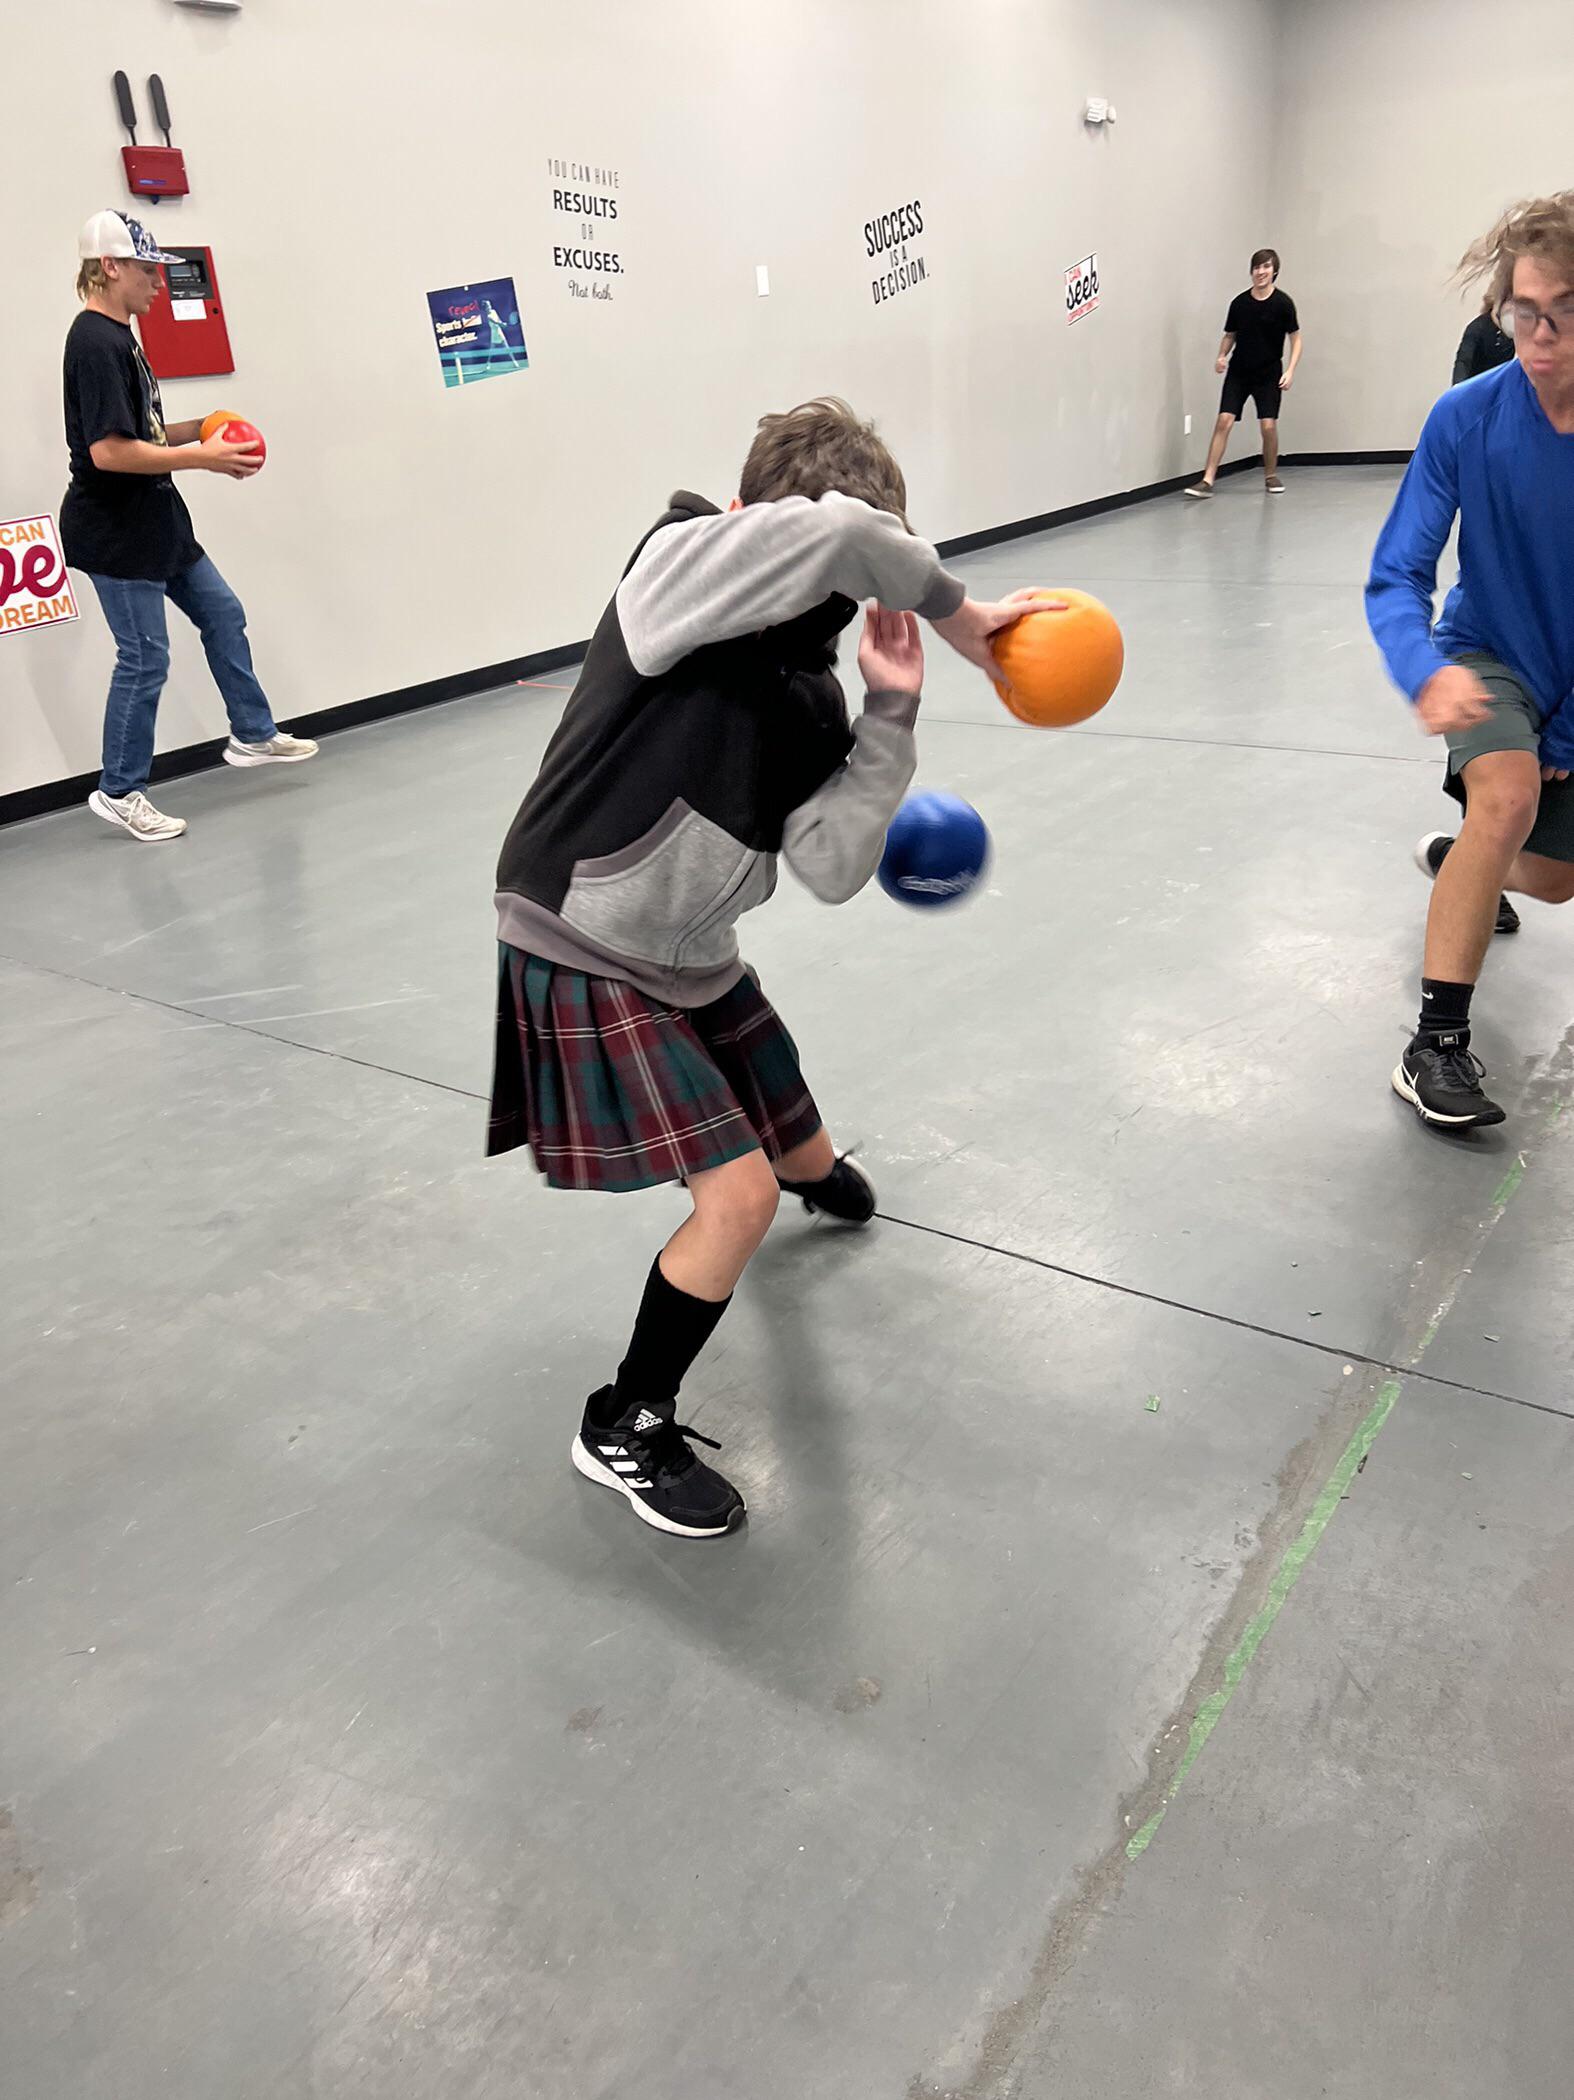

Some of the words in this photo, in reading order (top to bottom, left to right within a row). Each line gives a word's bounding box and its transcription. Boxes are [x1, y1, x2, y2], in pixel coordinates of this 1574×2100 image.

[548, 158, 567, 178] YOU
[571, 163, 590, 182] CAN
[595, 167, 619, 188] HAVE
[553, 189, 617, 219] RESULTS
[581, 223, 593, 240] OR
[864, 200, 923, 257] SUCCESS
[553, 246, 624, 274] EXCUSES.
[889, 248, 899, 268] IS
[901, 245, 907, 262] A
[568, 279, 588, 298] Not
[872, 256, 930, 304] DECISION.
[1066, 255, 1100, 310] seek
[0, 521, 45, 546] CAN
[0, 595, 73, 630] REAM
